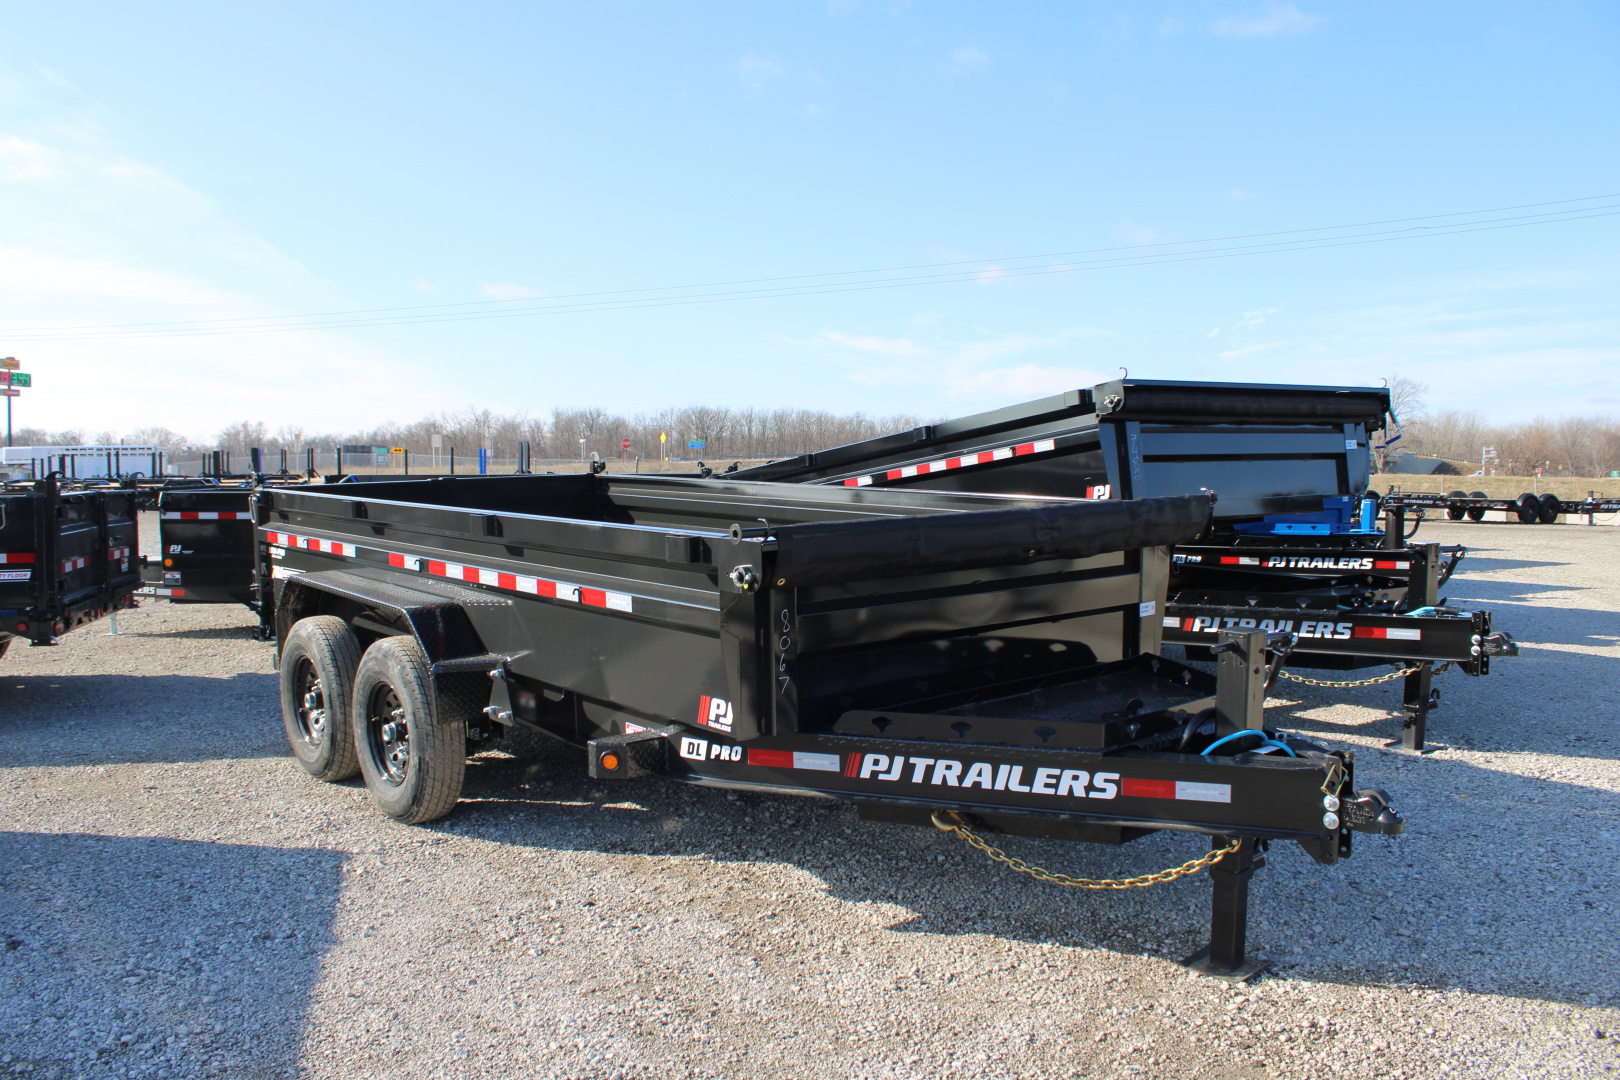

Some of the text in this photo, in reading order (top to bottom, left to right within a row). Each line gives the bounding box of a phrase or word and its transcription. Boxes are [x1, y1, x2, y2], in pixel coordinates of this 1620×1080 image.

[1093, 484, 1111, 499] PJ
[169, 544, 182, 552] PJ
[1187, 555, 1202, 563] PRO
[1267, 556, 1374, 570] PJ TRAILERS
[1192, 616, 1353, 639] PJ TRAILERS
[708, 697, 734, 726] PJ
[707, 720, 732, 733] TRAILERS
[710, 743, 743, 762] PRO
[859, 753, 1121, 800] PJ TRAILERS
